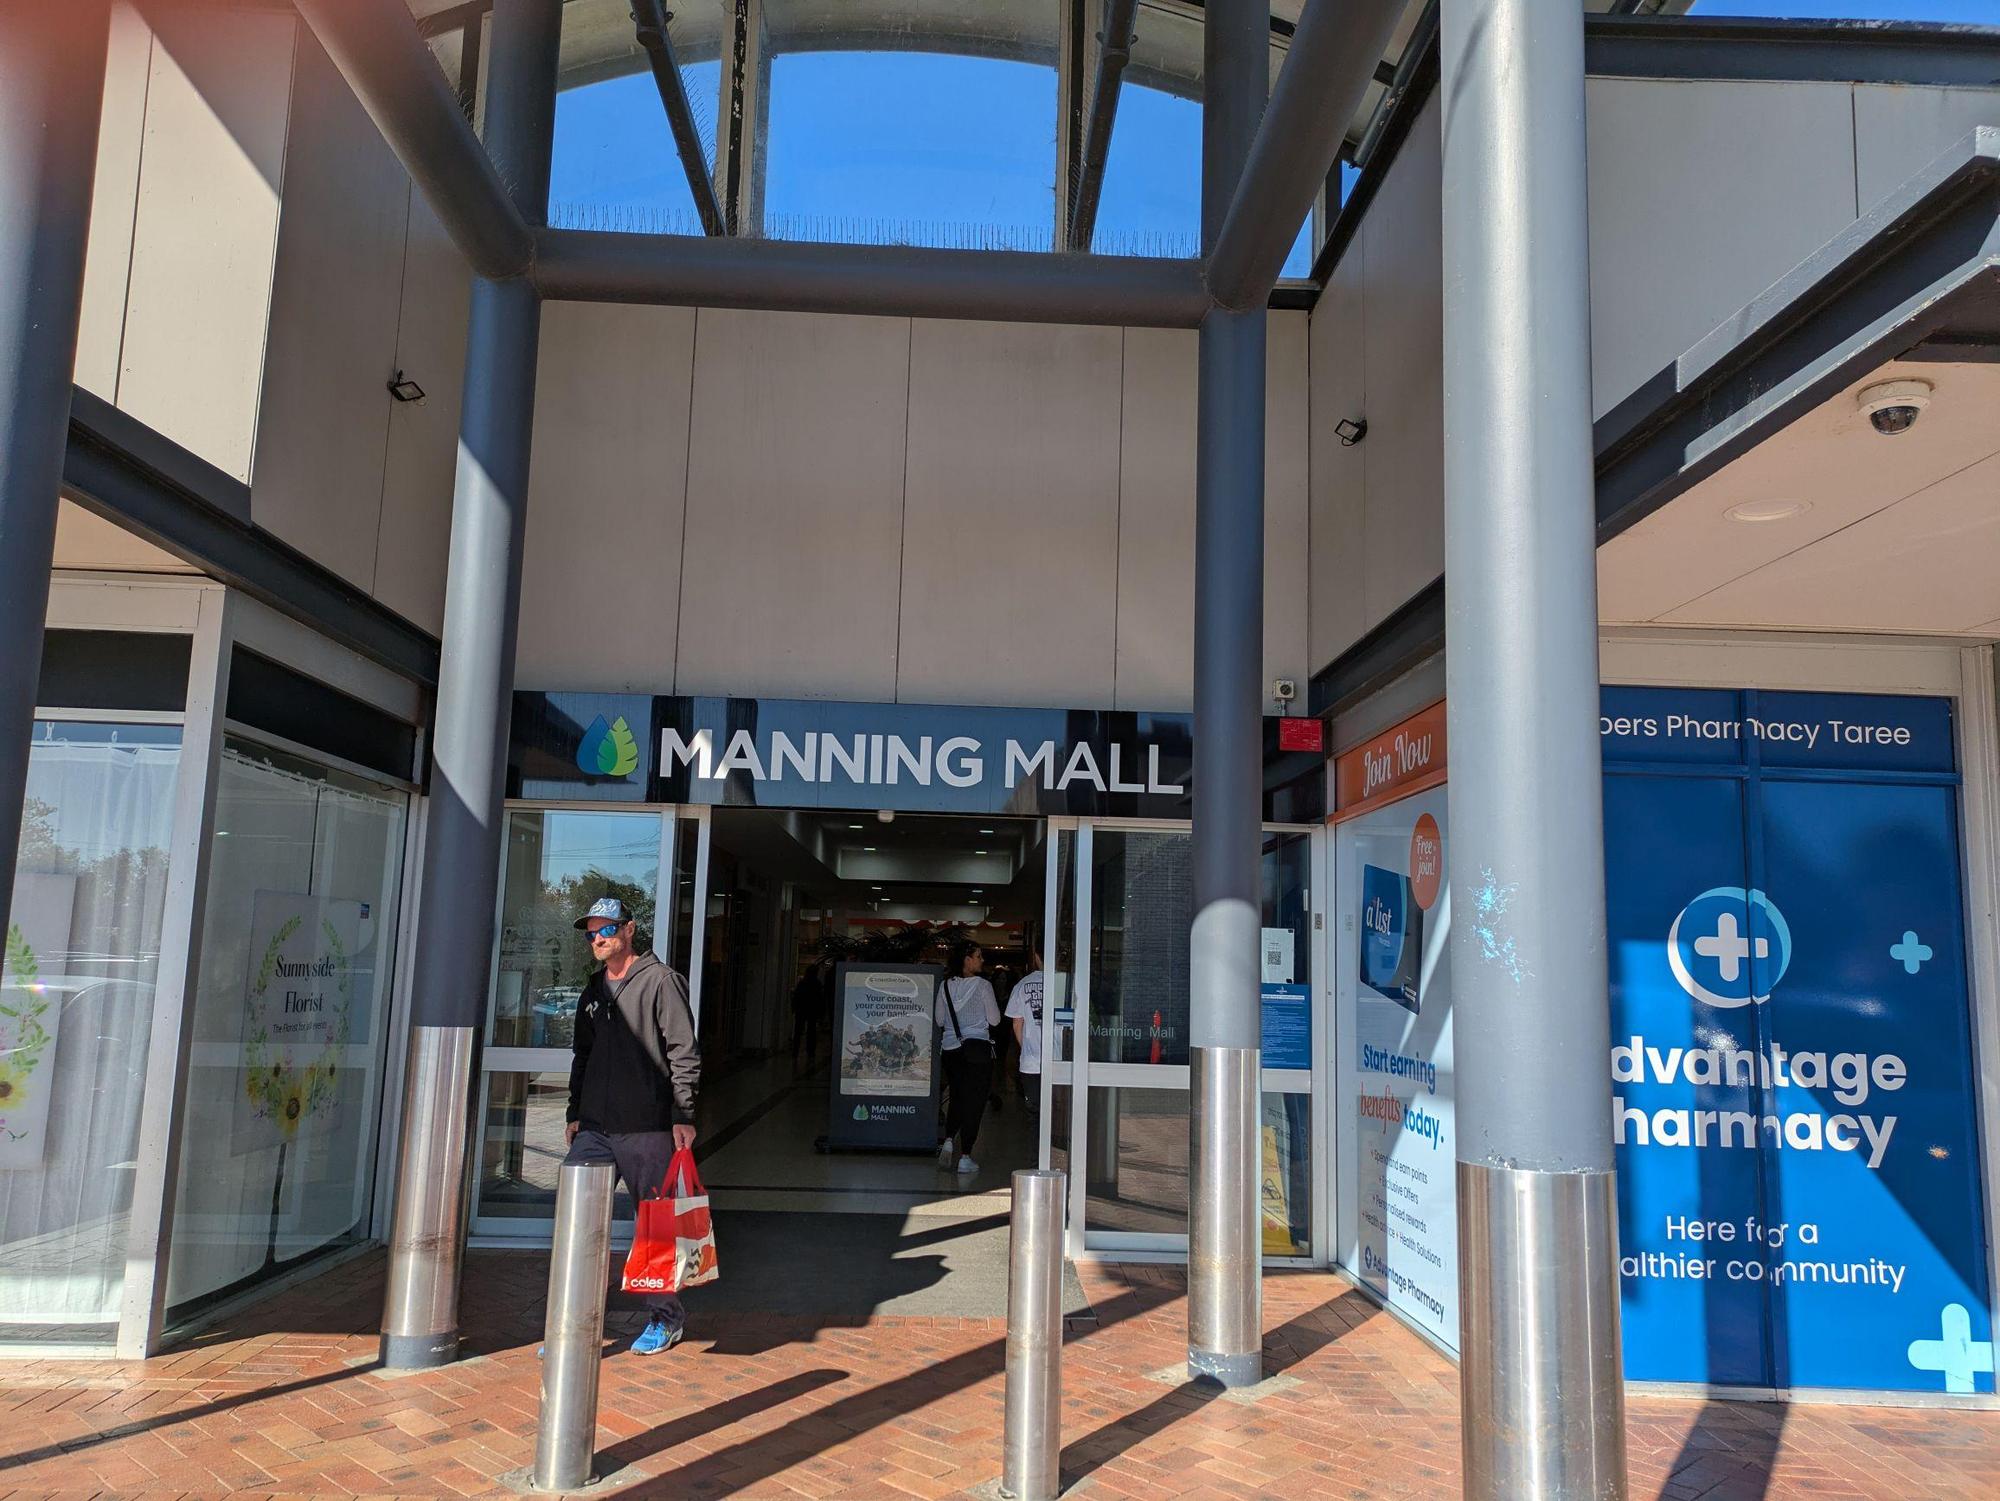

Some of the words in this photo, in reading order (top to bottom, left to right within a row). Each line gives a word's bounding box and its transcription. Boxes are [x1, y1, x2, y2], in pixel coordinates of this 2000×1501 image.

[1828, 721, 1911, 745] Taree
[660, 728, 984, 788] MANNING
[1004, 739, 1184, 794] MALL
[1363, 746, 1392, 798] Join
[1394, 731, 1432, 777] Now
[1416, 835, 1433, 855] Free
[1375, 896, 1393, 936] list
[275, 954, 335, 982] Sunnyside
[284, 990, 324, 1014] Florist
[855, 1002, 874, 1011] your
[875, 1003, 926, 1013] community,
[866, 993, 886, 1003] Your
[887, 995, 913, 1005] coast,
[866, 1010, 885, 1019] your
[1090, 1024, 1142, 1040] Manning
[1149, 1026, 1175, 1039] Mall
[1363, 1043, 1389, 1074] Start
[1390, 1051, 1436, 1096] earning
[1611, 1035, 1907, 1106] dvantage
[871, 1104, 916, 1114] MANNING
[1360, 1080, 1401, 1135] benefits
[1403, 1103, 1445, 1151] today.
[1612, 1096, 1898, 1169] harmacy
[1411, 1167, 1428, 1185] points
[1405, 1213, 1427, 1234] rewards
[1666, 1215, 1735, 1242] Here
[1798, 1222, 1819, 1244] a
[1416, 1241, 1442, 1268] Solutions
[1619, 1251, 1716, 1279] althier
[630, 1277, 665, 1289] coles
[1372, 1254, 1407, 1294] Advantage
[1407, 1277, 1445, 1324] Pharmacy
